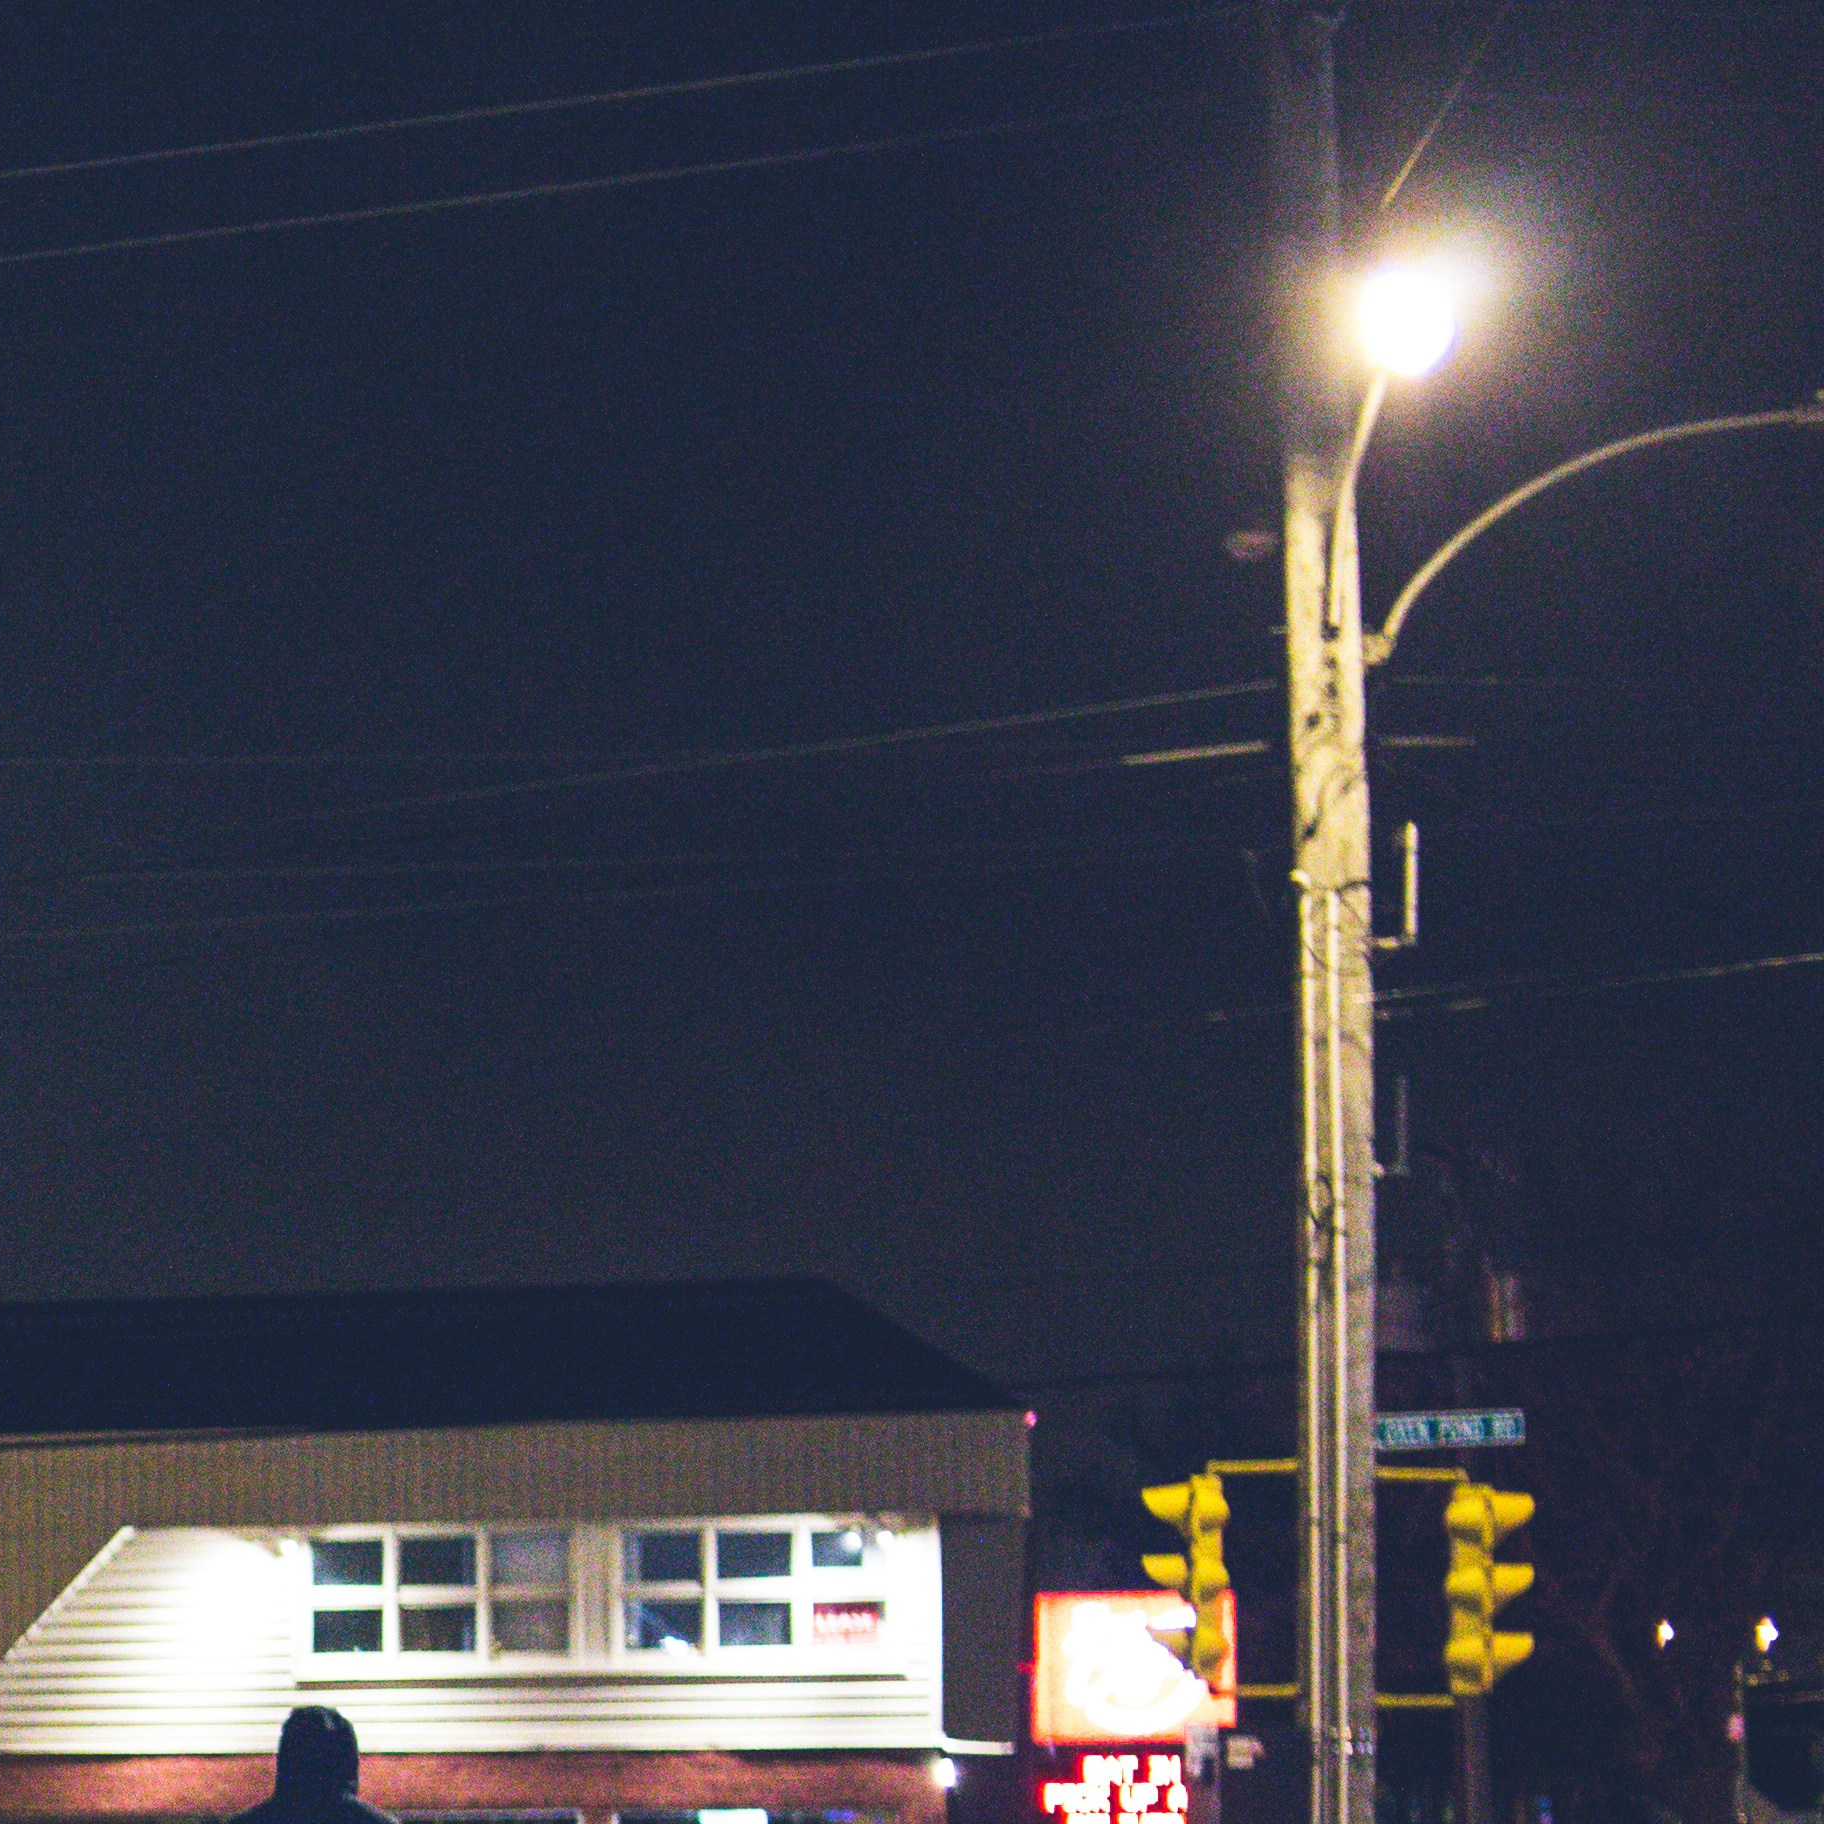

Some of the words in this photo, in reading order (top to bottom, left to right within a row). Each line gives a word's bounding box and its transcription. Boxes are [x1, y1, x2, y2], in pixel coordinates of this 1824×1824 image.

[1085, 1755, 1137, 1784] EAT
[1046, 1783, 1109, 1813] PICK
[1121, 1783, 1158, 1813] UP
